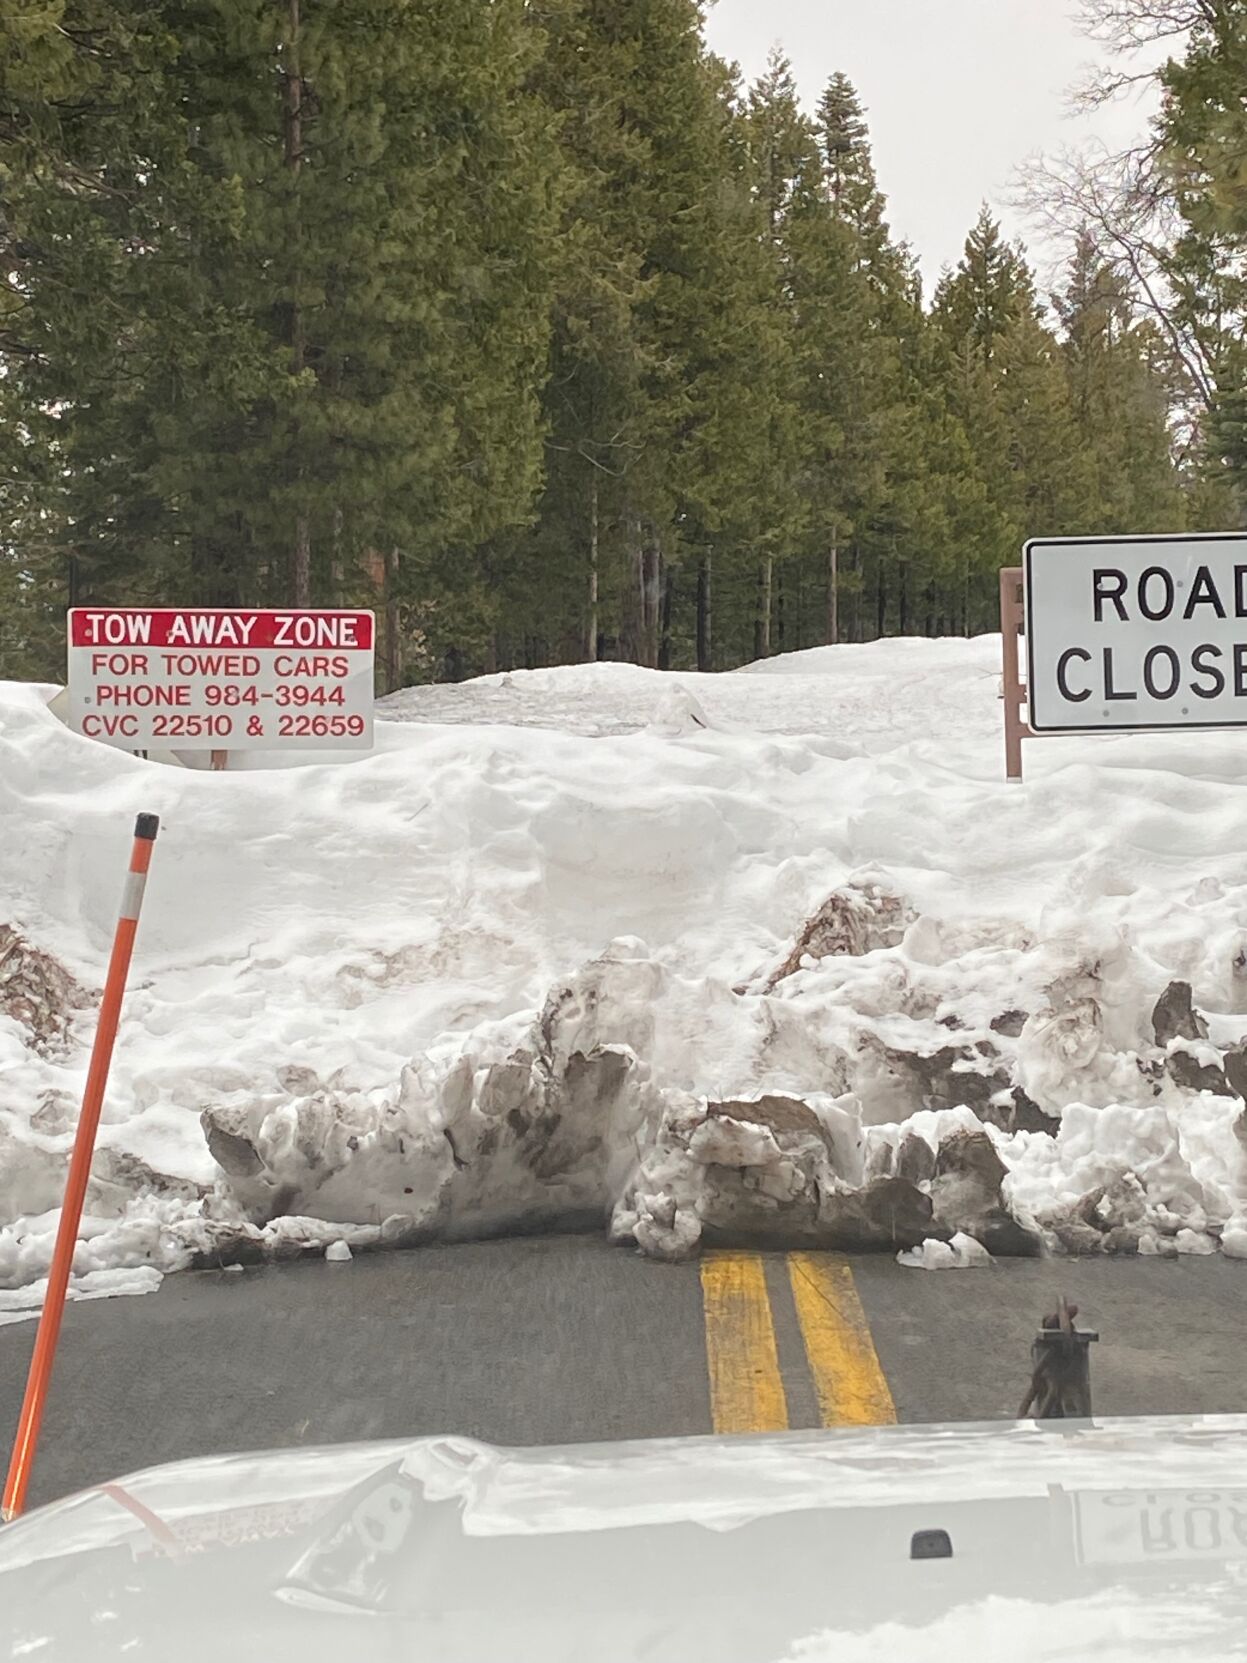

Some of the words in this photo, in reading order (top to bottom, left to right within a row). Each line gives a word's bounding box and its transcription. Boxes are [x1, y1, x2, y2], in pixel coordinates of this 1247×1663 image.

[86, 614, 152, 643] TOW
[167, 615, 257, 645] AWAY
[273, 616, 359, 647] ZONE
[91, 653, 149, 676] FOR
[161, 654, 261, 677] TOWED
[273, 656, 349, 678] CARS
[96, 684, 191, 706] PHONE
[204, 685, 346, 706] 984-3944
[81, 714, 139, 737] CVC
[152, 715, 233, 737] 22510
[246, 715, 264, 737] &
[278, 715, 365, 737] 22659
